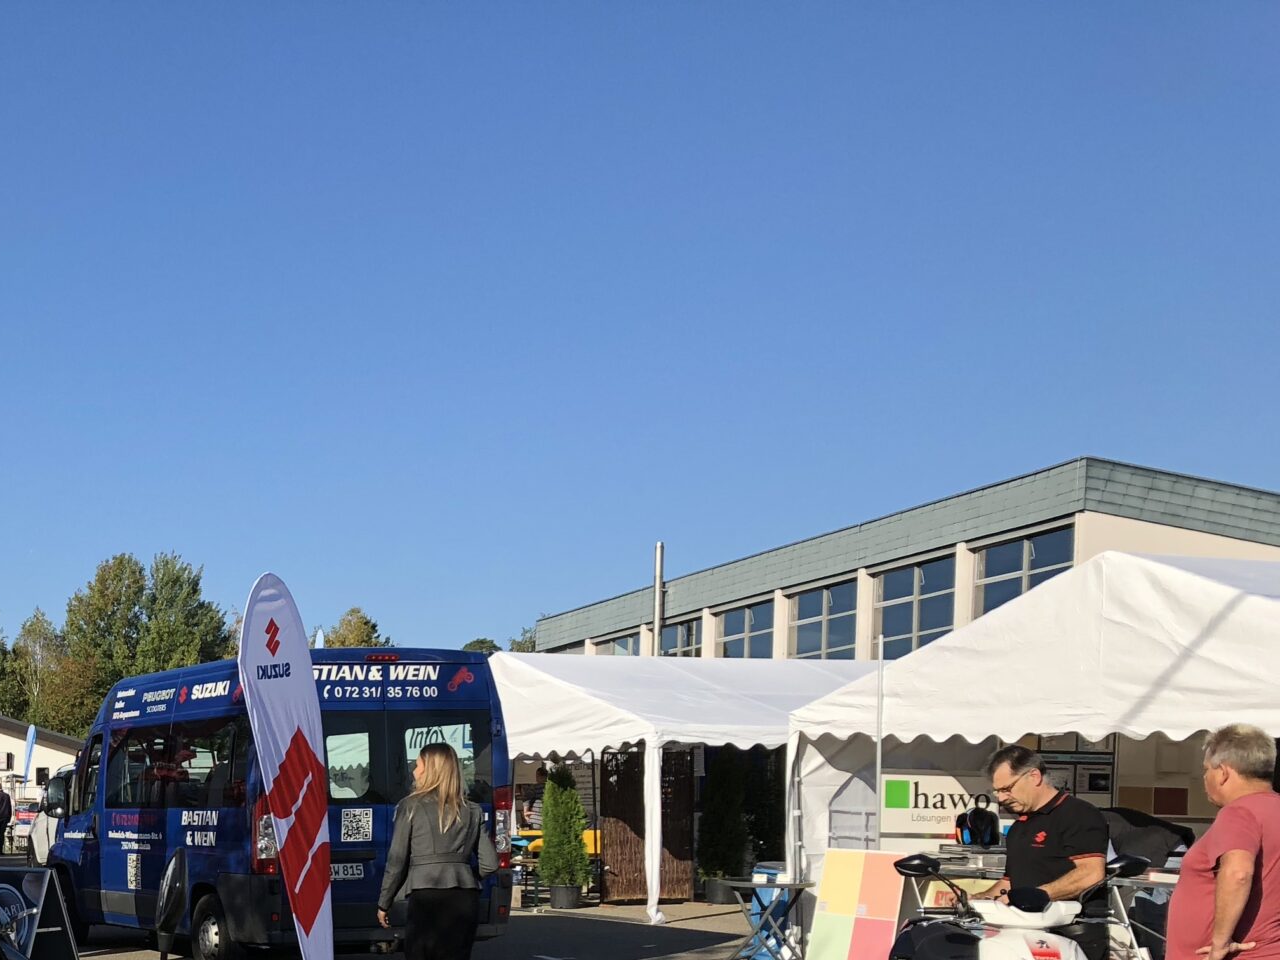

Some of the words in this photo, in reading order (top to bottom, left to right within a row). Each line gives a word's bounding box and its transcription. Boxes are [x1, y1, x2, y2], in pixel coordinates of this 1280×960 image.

[368, 665, 384, 681] &
[389, 665, 440, 681] WEIN
[142, 688, 176, 703] PEUGEOT
[191, 680, 230, 700] SUZUKI
[344, 686, 360, 698] 72
[362, 686, 381, 698] 31/
[387, 686, 402, 698] 35
[405, 686, 421, 698] 76
[422, 686, 438, 698] 00
[911, 781, 991, 810] hawo
[181, 811, 218, 826] BASTIAN
[911, 813, 951, 825] Lösungen
[186, 832, 193, 845] &
[194, 831, 216, 846] WEIN
[343, 864, 363, 876] 815
